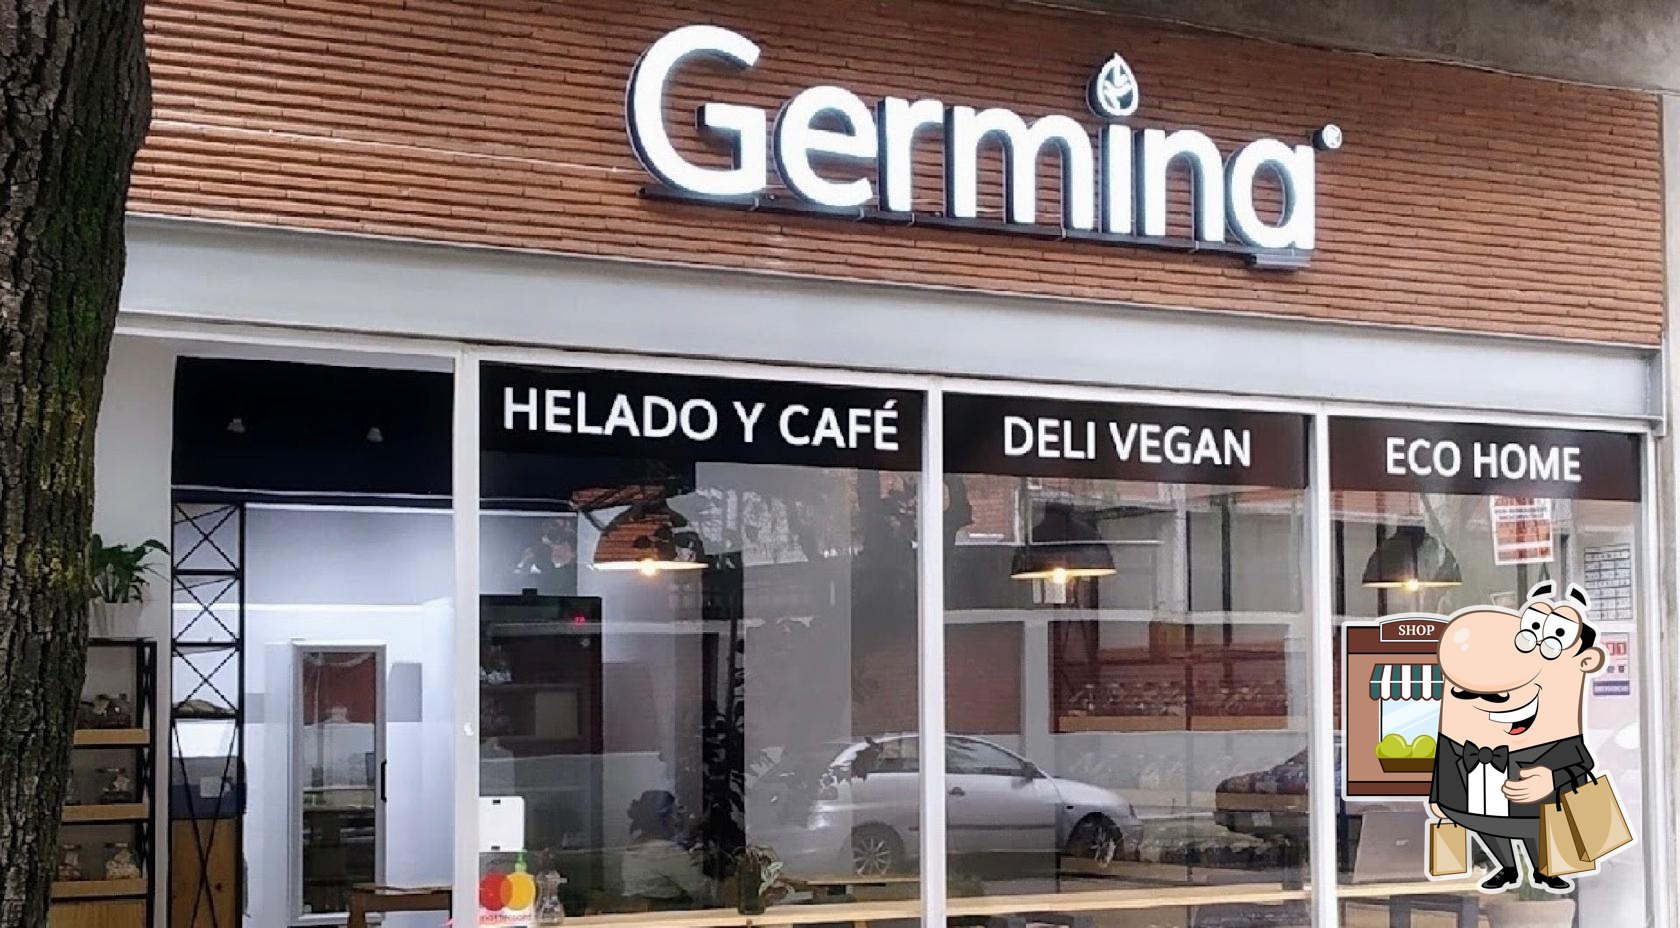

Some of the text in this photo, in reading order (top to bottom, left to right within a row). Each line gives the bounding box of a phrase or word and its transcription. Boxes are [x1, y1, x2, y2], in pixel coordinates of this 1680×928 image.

[629, 24, 1315, 251] Germina
[503, 387, 899, 451] HELADO Y CAFÉ
[1003, 416, 1251, 467] DELI VEGAN
[1386, 436, 1582, 482] ECO HOME
